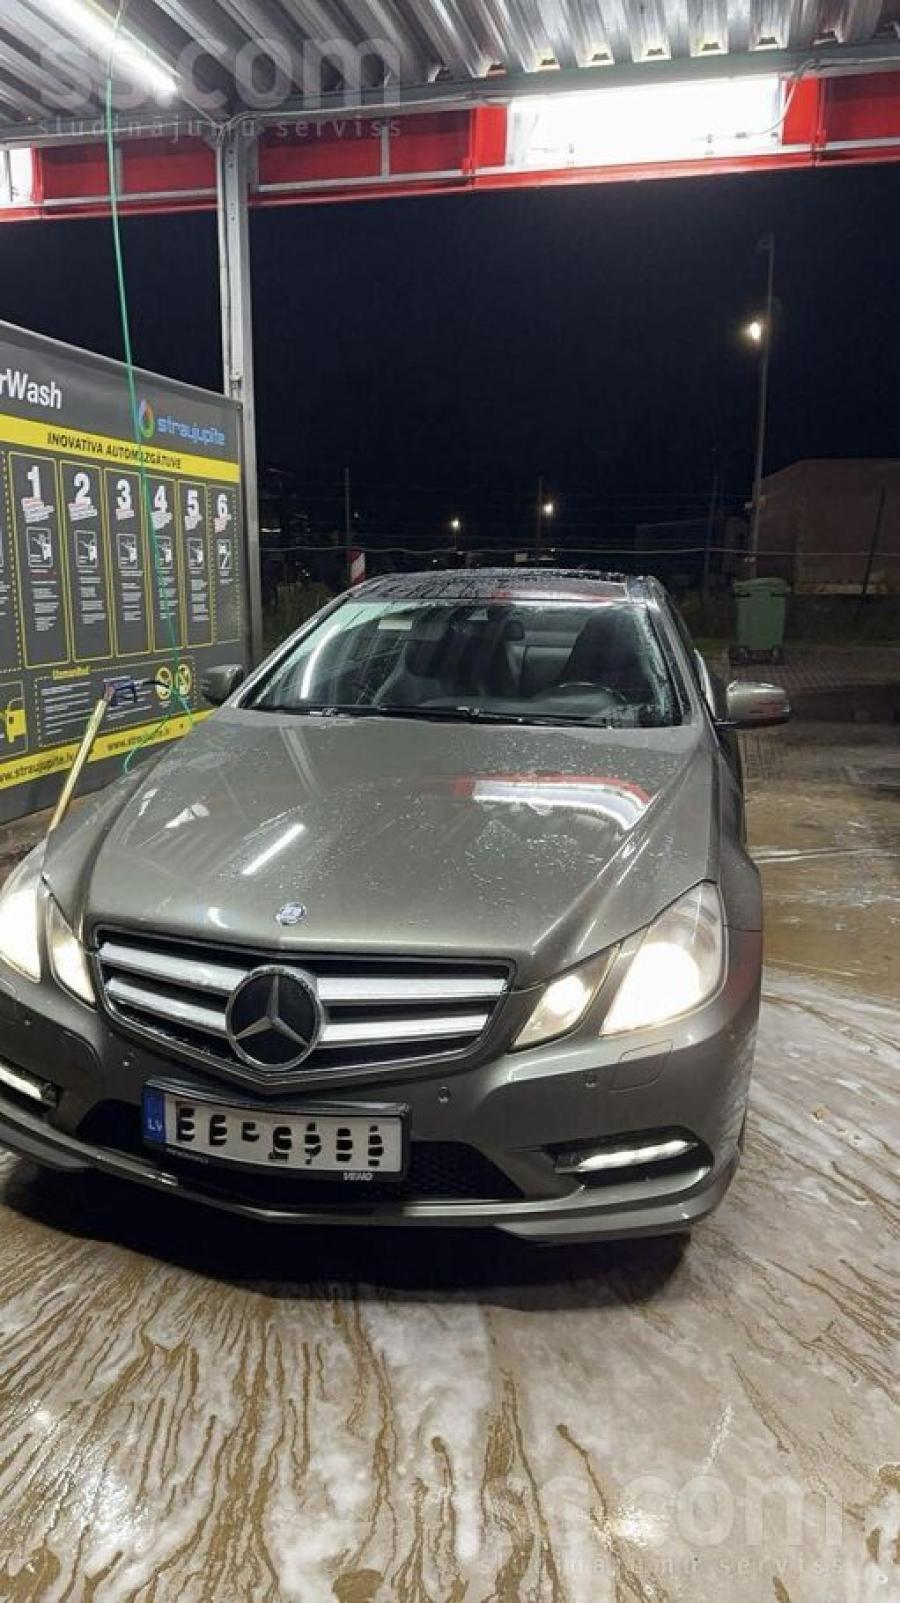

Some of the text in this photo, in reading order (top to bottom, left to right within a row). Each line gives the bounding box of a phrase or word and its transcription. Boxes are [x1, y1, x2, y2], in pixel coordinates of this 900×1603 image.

[0, 368, 62, 409] rWash
[27, 465, 41, 500] 1
[74, 472, 91, 504] 2
[117, 479, 131, 509] 3
[155, 486, 168, 513] 4
[187, 489, 200, 516] 5
[217, 493, 228, 516] 6
[148, 1118, 163, 1131] LV
